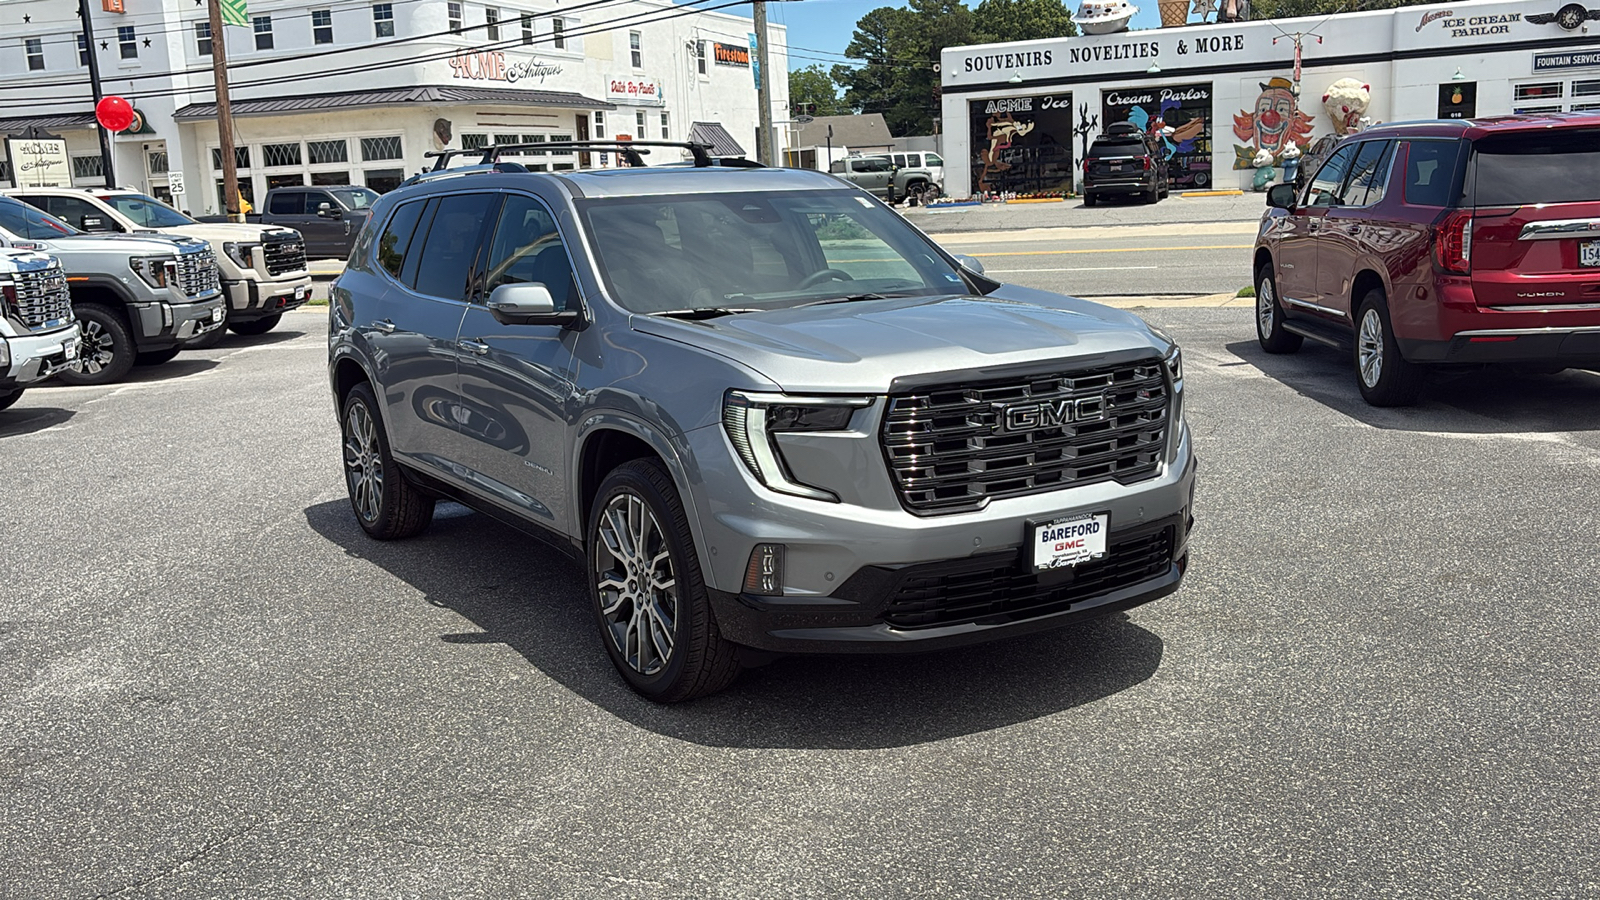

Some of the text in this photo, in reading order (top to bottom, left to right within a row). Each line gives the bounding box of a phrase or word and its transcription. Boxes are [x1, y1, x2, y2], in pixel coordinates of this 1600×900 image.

[1442, 13, 1521, 28] ICE CREAM
[1451, 25, 1509, 37] PARLOR
[714, 43, 748, 63] Firestone
[965, 35, 1244, 72] SOUVENIRS NOVELTIES & MORE
[1537, 54, 1600, 67] FOUNTAIN SERVICE
[449, 47, 563, 84] ACME Antiques
[611, 80, 655, 97] Dutch Boy Paints
[1106, 88, 1209, 106] Cream Parlor
[985, 96, 1070, 114] ACME Ice
[20, 142, 60, 154] ACME
[21, 158, 63, 171] Antiques
[171, 183, 184, 192] 25
[1006, 396, 1103, 430] GMC
[1053, 513, 1092, 525] TAPPAHANNOCK
[1042, 521, 1100, 543] BAREFORD
[1054, 538, 1085, 552] GMC
[1048, 551, 1092, 569] Bareford
